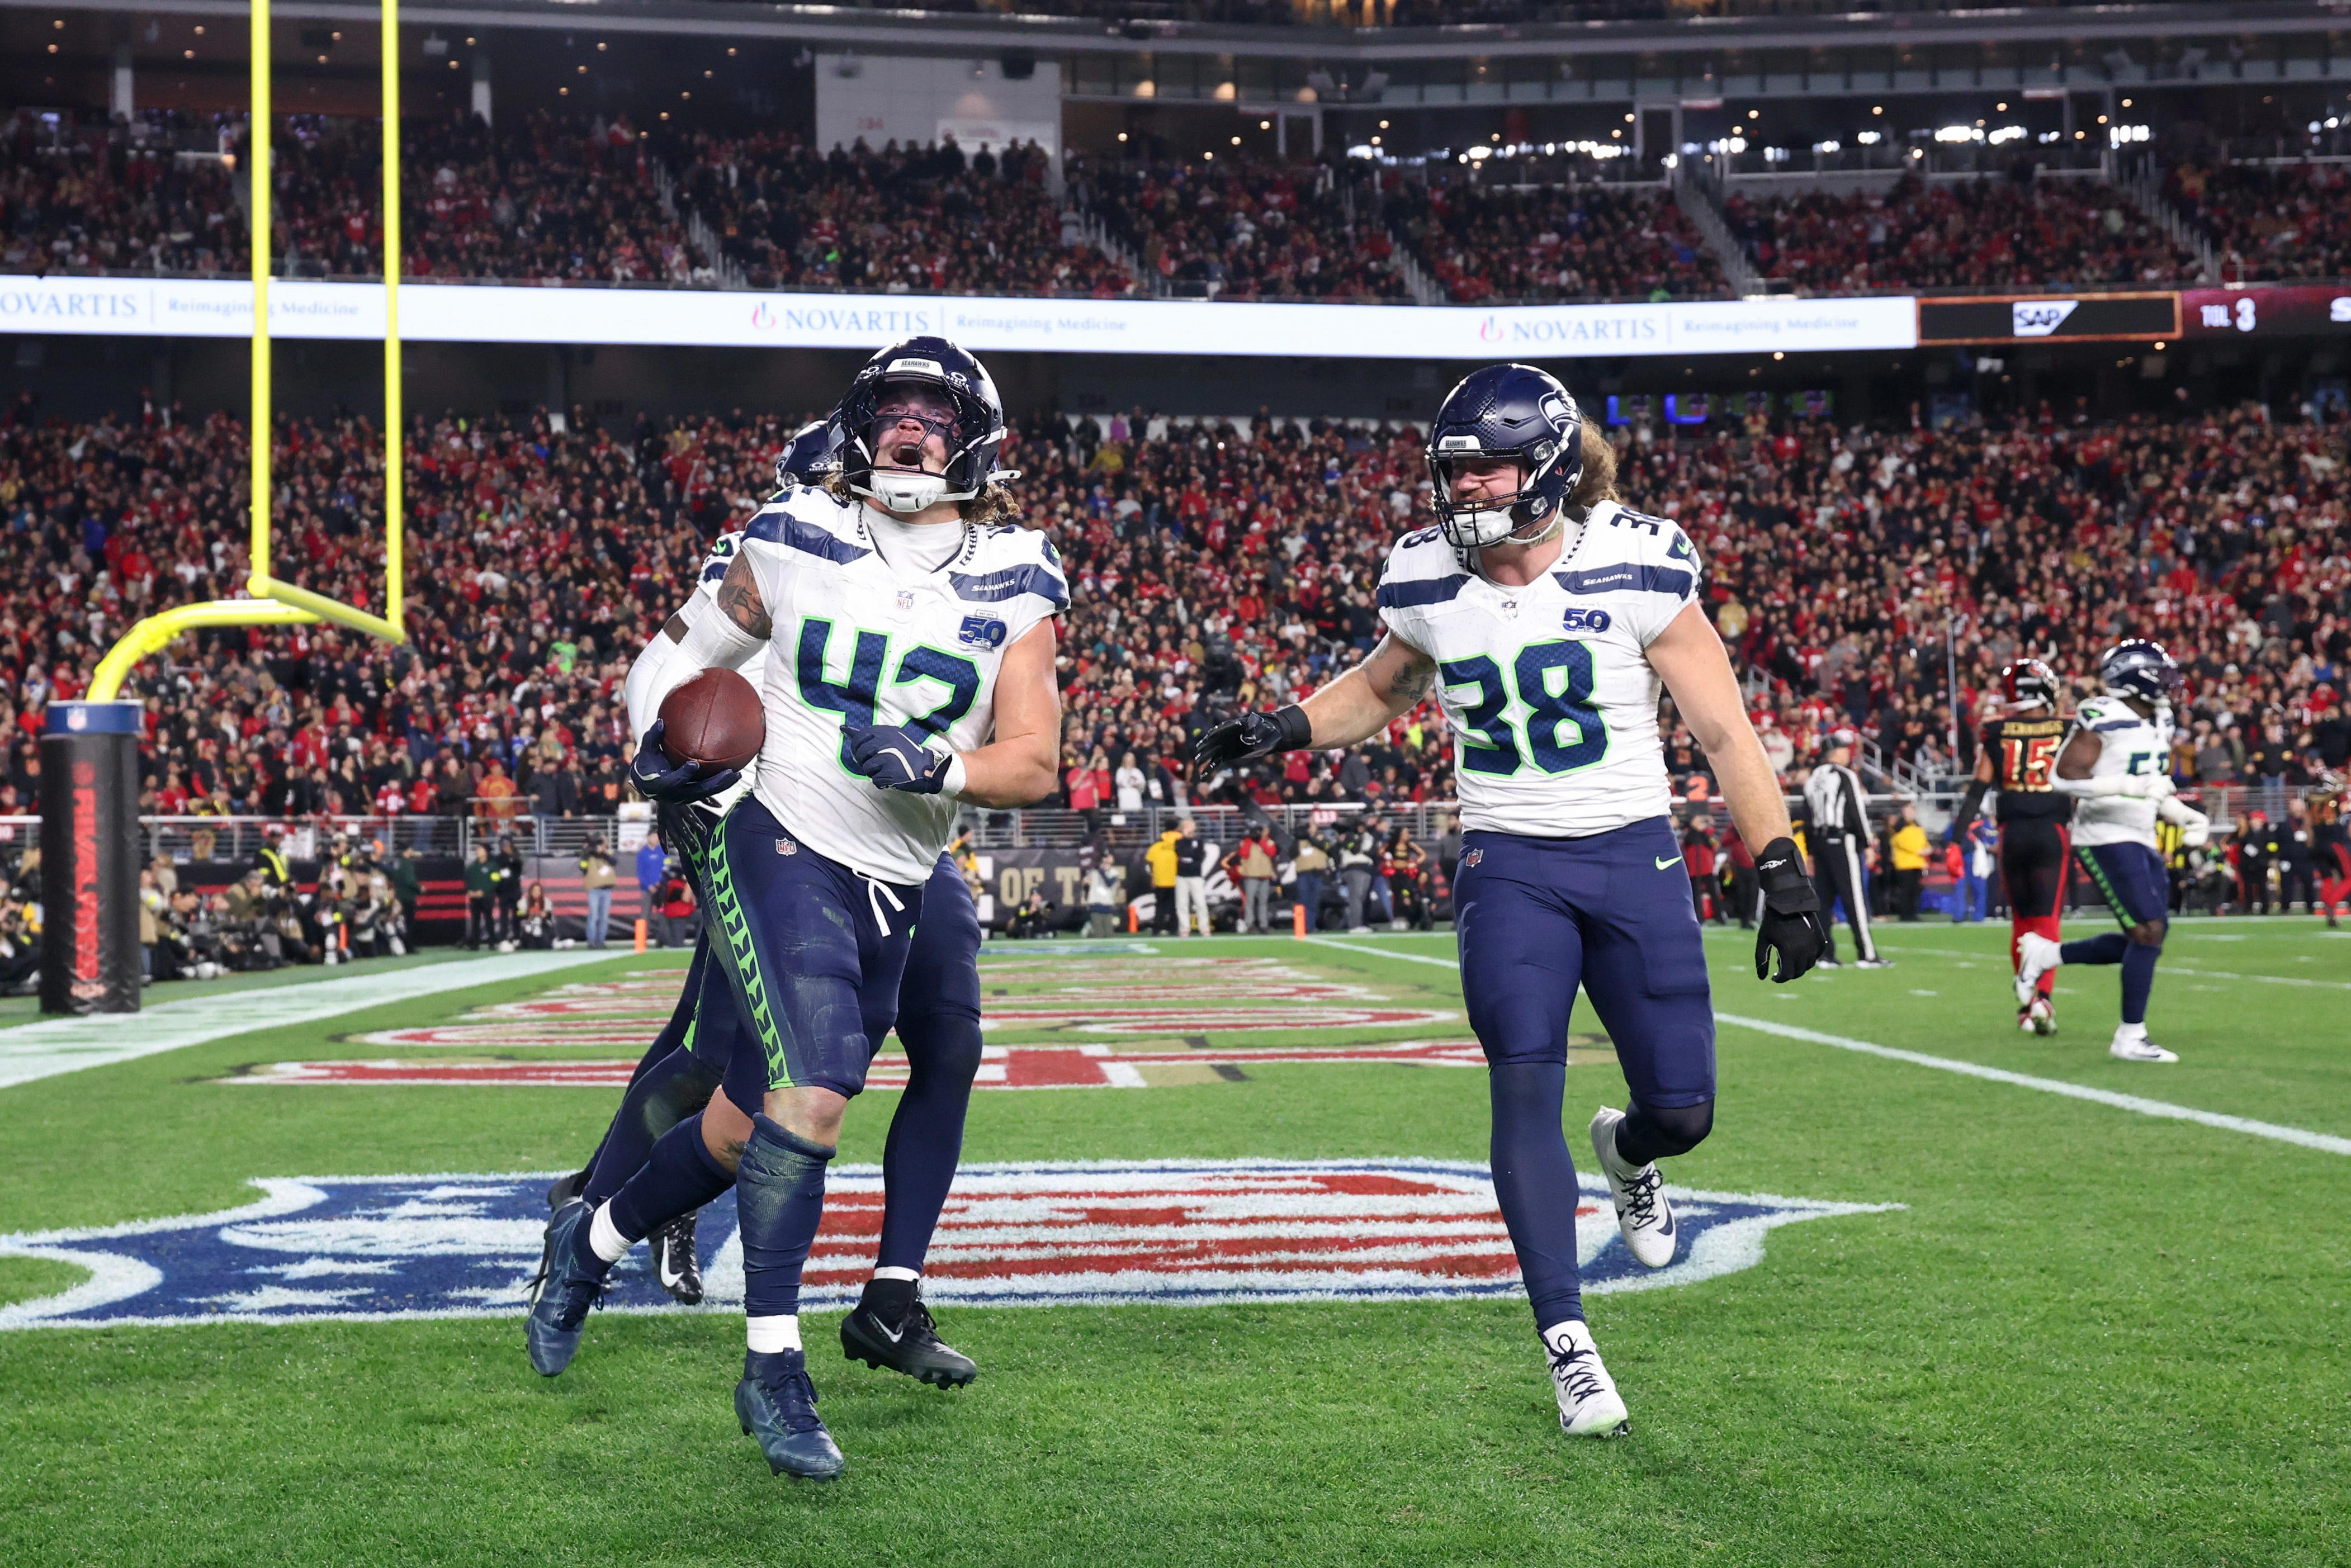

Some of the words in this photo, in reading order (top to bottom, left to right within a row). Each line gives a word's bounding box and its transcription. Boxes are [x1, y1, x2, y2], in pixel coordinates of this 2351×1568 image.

[169, 299, 275, 316] Reimaginig
[281, 301, 358, 315] Medicine
[2016, 308, 2061, 328] SAP
[2235, 297, 2256, 331] 3
[786, 309, 929, 332] NOVARTIS
[957, 314, 1052, 333] Reimagining
[1058, 316, 1127, 331] Medicine
[1513, 318, 1655, 342] NOVARTIS
[972, 579, 1015, 591] SEAHAWKS
[1583, 574, 1633, 586] SEAHAWKS
[959, 615, 1007, 647] 50
[1563, 608, 1611, 633] 50
[795, 615, 983, 780] 42
[1439, 639, 1611, 779] 38
[2000, 735, 2062, 793] 15
[1686, 775, 1709, 802] 2
[999, 866, 1045, 907] OF
[1054, 866, 1127, 907] TE
